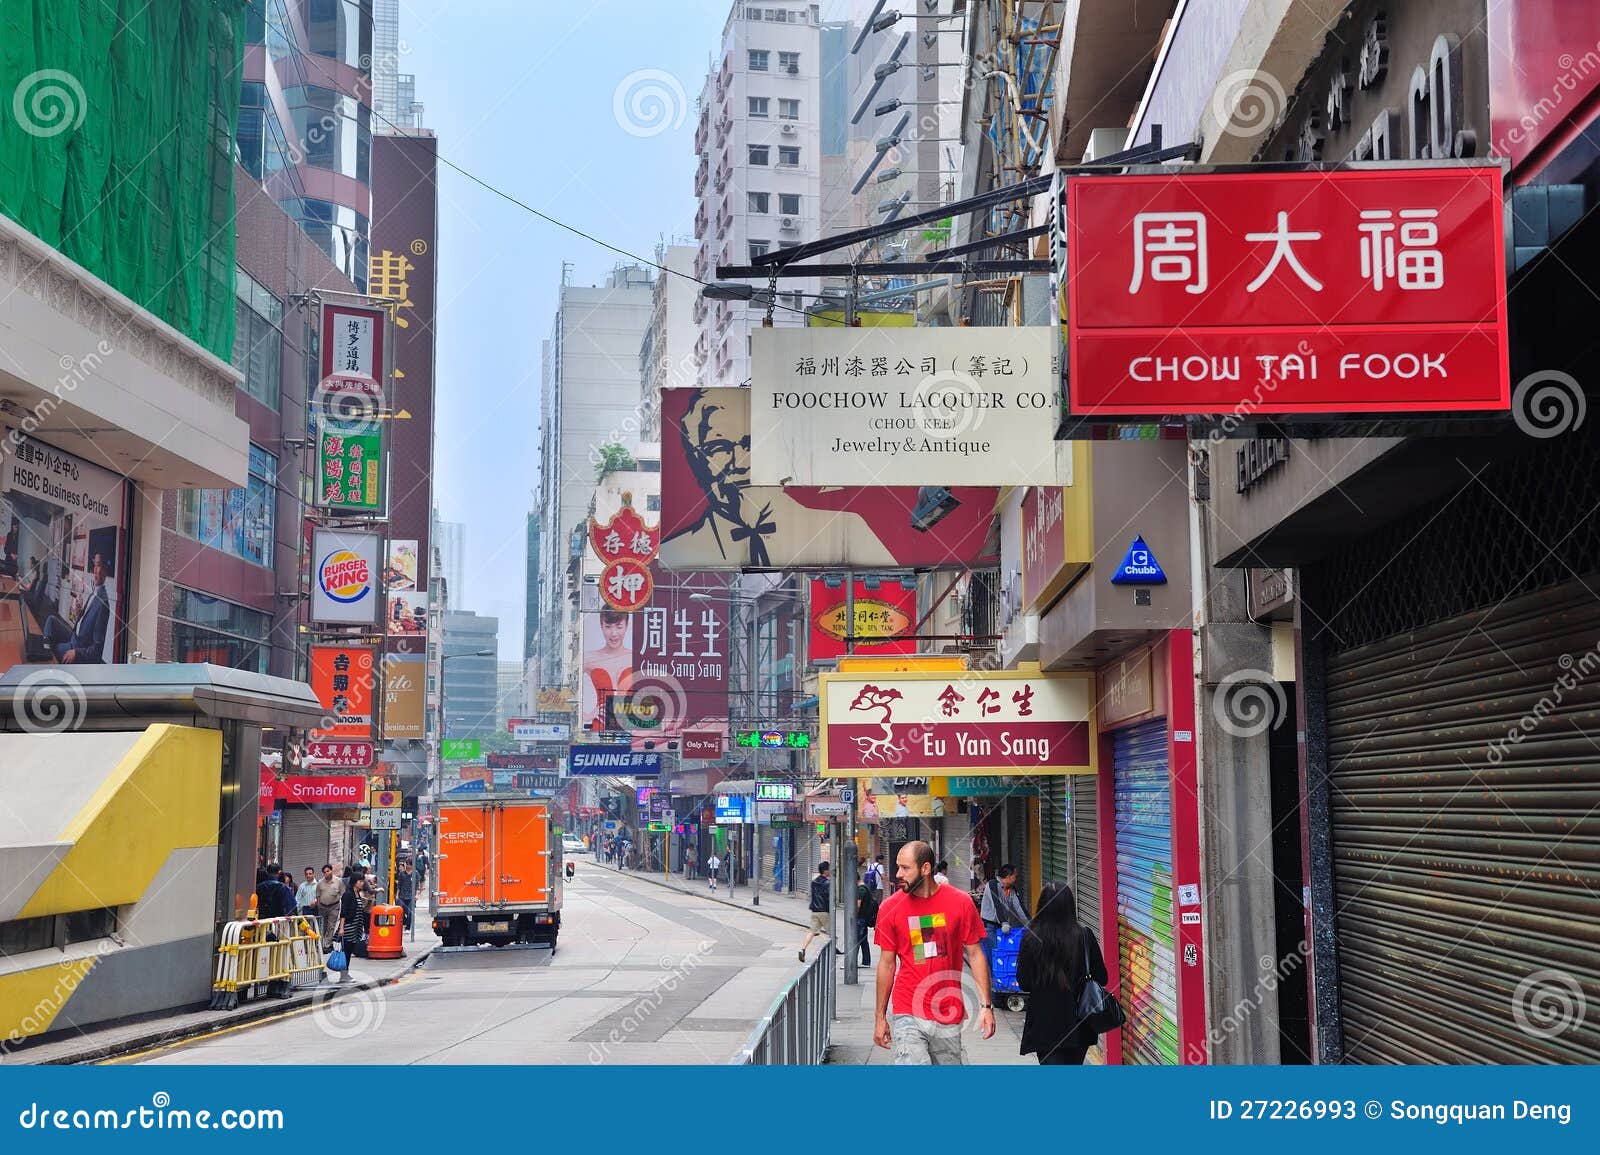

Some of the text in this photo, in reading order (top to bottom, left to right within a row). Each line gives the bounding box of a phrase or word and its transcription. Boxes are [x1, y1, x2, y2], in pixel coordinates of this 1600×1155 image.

[1129, 208, 1445, 295] 周大福
[346, 320, 360, 372] 博多道場
[1129, 352, 1448, 382] CHOW TAI FOOK
[771, 391, 889, 410] FOOCHOW
[898, 391, 1006, 412] LACQUER
[1015, 391, 1054, 410] CO.
[867, 417, 957, 431] (CHOU KEE)
[13, 465, 109, 517] HSBC Business Centre
[323, 559, 368, 578] BURGER
[1124, 564, 1157, 576] Chubb
[325, 568, 369, 593] KING
[607, 565, 645, 604] 押
[639, 606, 722, 658] 周生生
[640, 660, 722, 682] Chow Sang Sang
[613, 702, 655, 715] Nikon
[937, 683, 1035, 718] 余仁生
[686, 740, 702, 750] Only
[703, 740, 716, 749] You
[923, 731, 1050, 762] Eu Yan Sang
[573, 753, 630, 767] SUNING
[292, 783, 357, 797] SmarTone
[375, 819, 397, 829] 終止
[379, 809, 394, 818] End
[440, 831, 485, 841] KERRY
